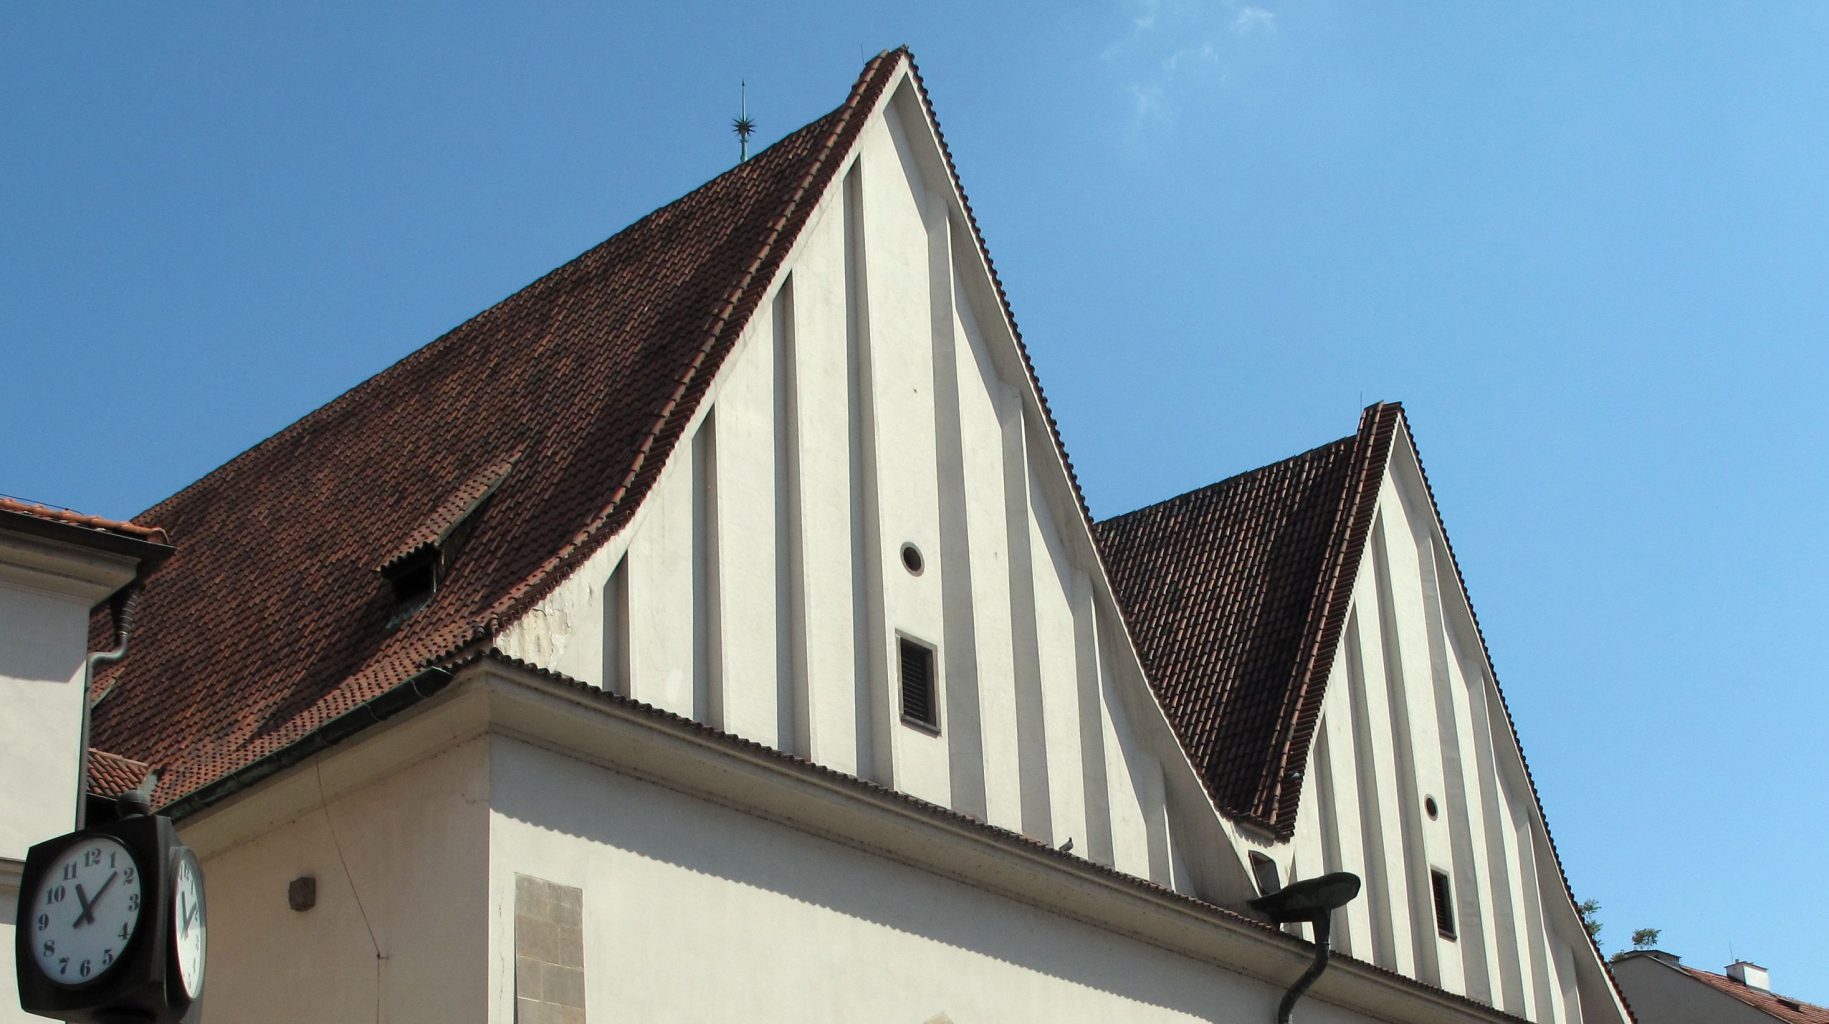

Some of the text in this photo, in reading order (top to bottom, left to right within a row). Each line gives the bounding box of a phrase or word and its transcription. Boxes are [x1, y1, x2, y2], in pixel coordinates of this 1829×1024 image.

[84, 848, 101, 868] 12
[110, 851, 116, 869] 1
[64, 862, 77, 881] 11
[123, 867, 135, 885] 2
[47, 885, 65, 905] 10
[128, 893, 139, 912] 3
[38, 913, 49, 931] 9
[118, 922, 129, 940] 4
[43, 940, 55, 957] 8
[103, 948, 113, 965] 5
[59, 957, 69, 975] 7
[80, 959, 91, 977] 6
